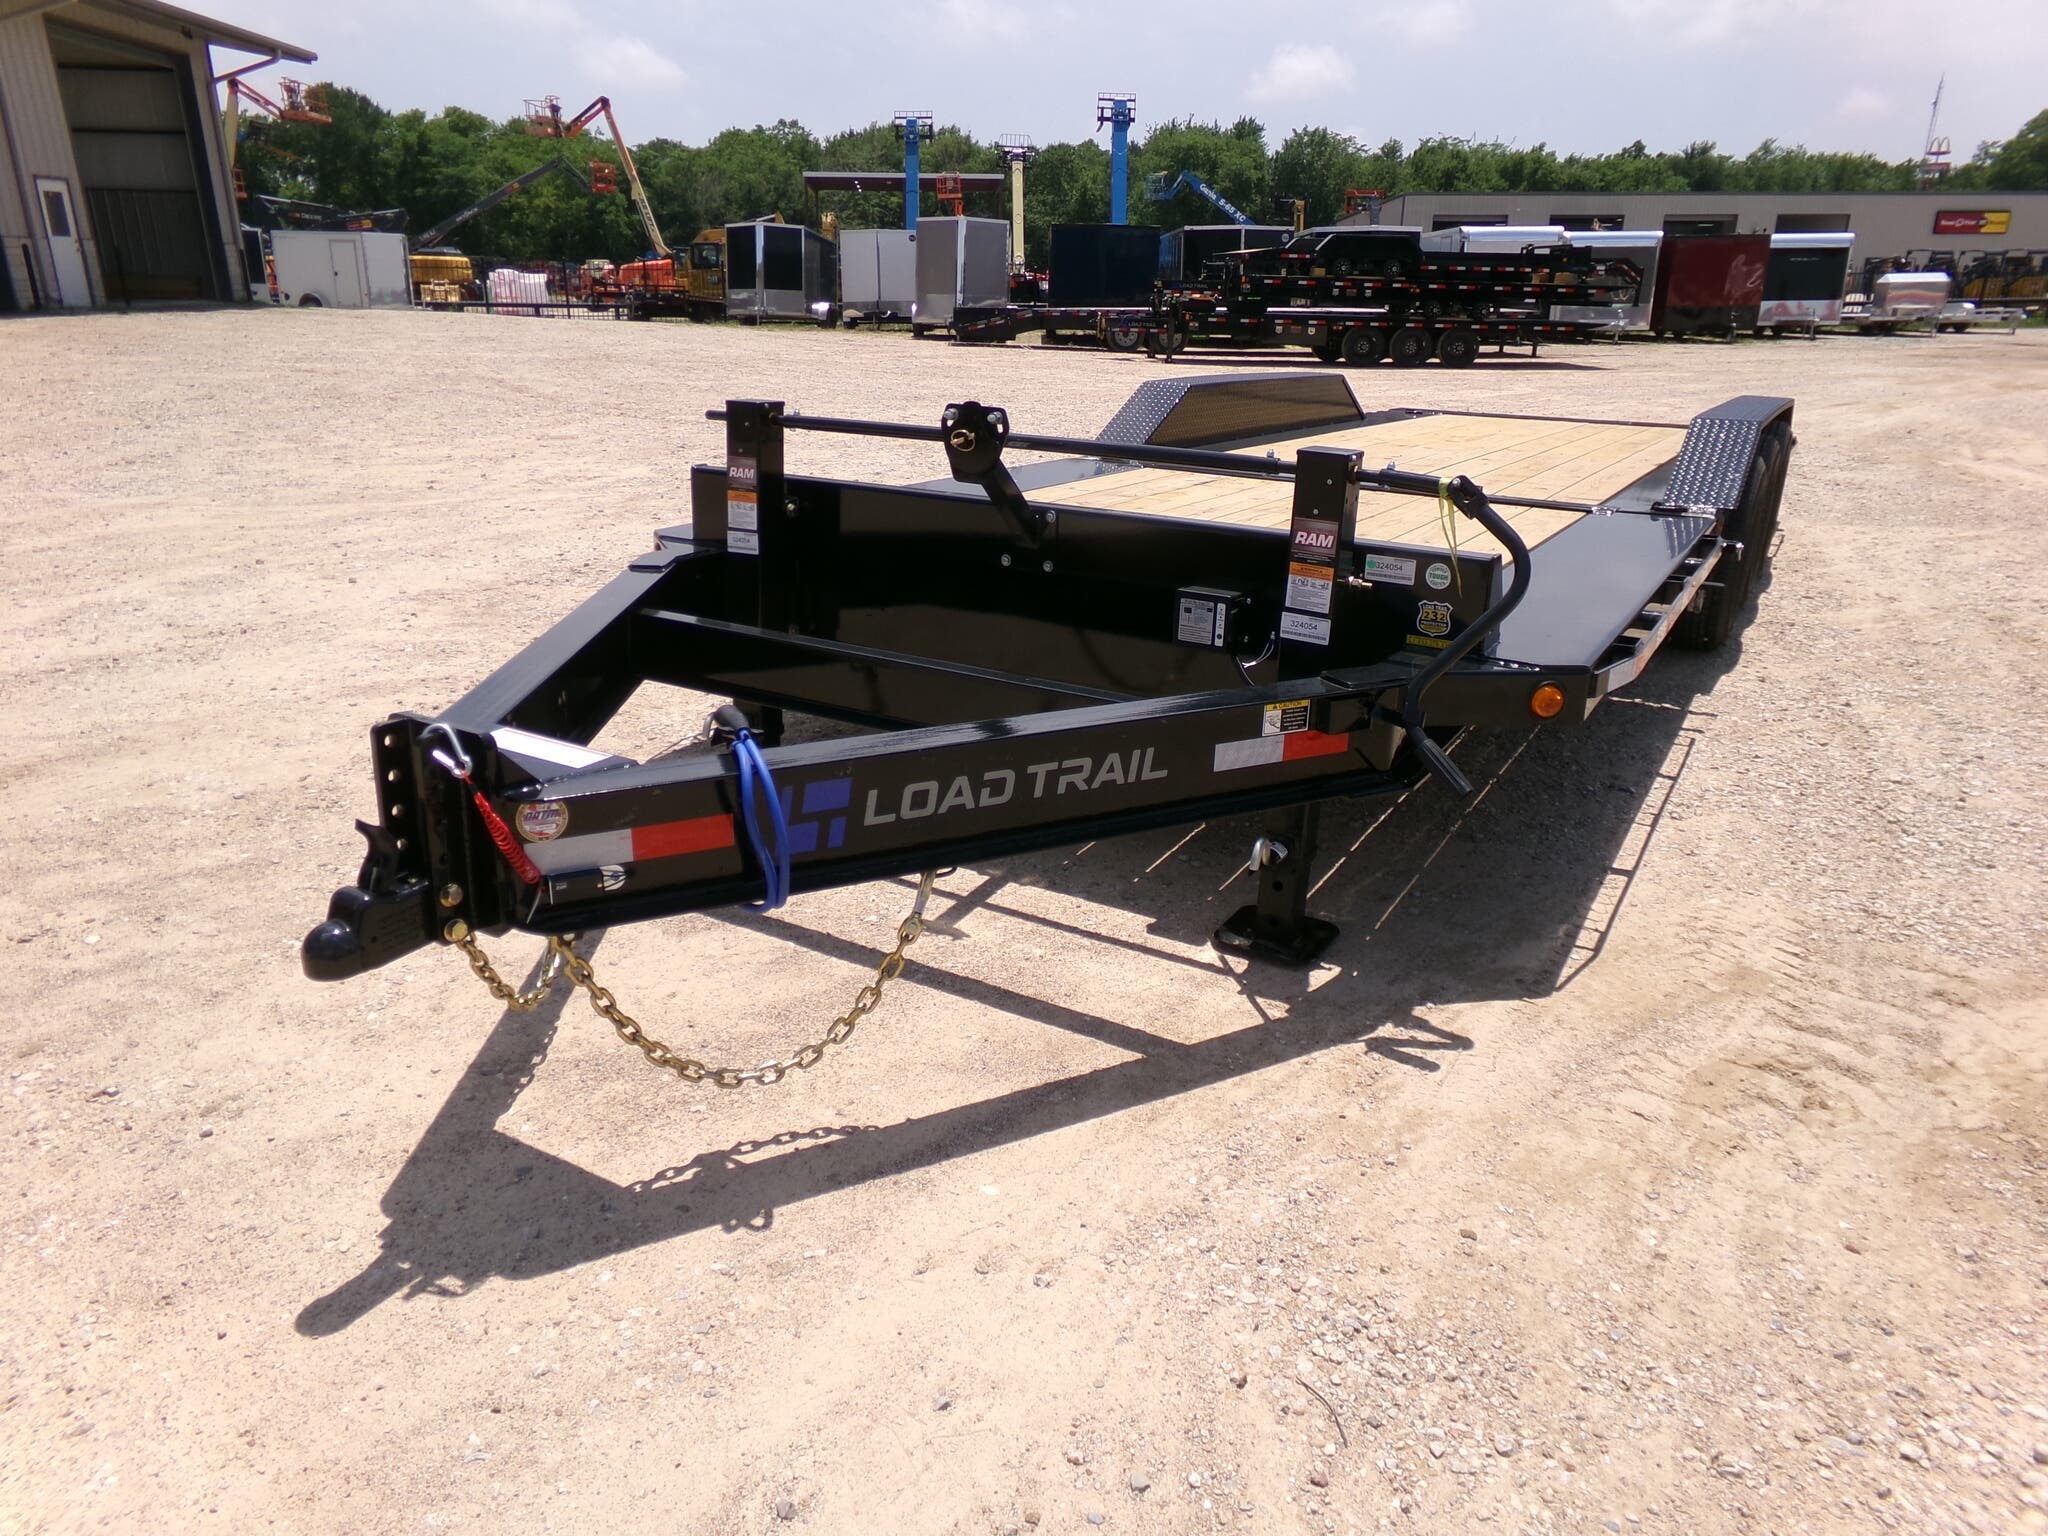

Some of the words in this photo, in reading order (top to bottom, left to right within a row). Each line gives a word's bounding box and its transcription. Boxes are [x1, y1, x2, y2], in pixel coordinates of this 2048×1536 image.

[1200, 183, 1217, 200] Genie
[1234, 211, 1247, 222] XC
[729, 467, 755, 480] RAM
[1295, 531, 1334, 549] RAM
[1375, 561, 1403, 572] 324054
[1424, 611, 1446, 622] 232
[1290, 619, 1318, 631] 324054
[863, 768, 1016, 827] LOAD
[1026, 746, 1169, 800] TRAIL
